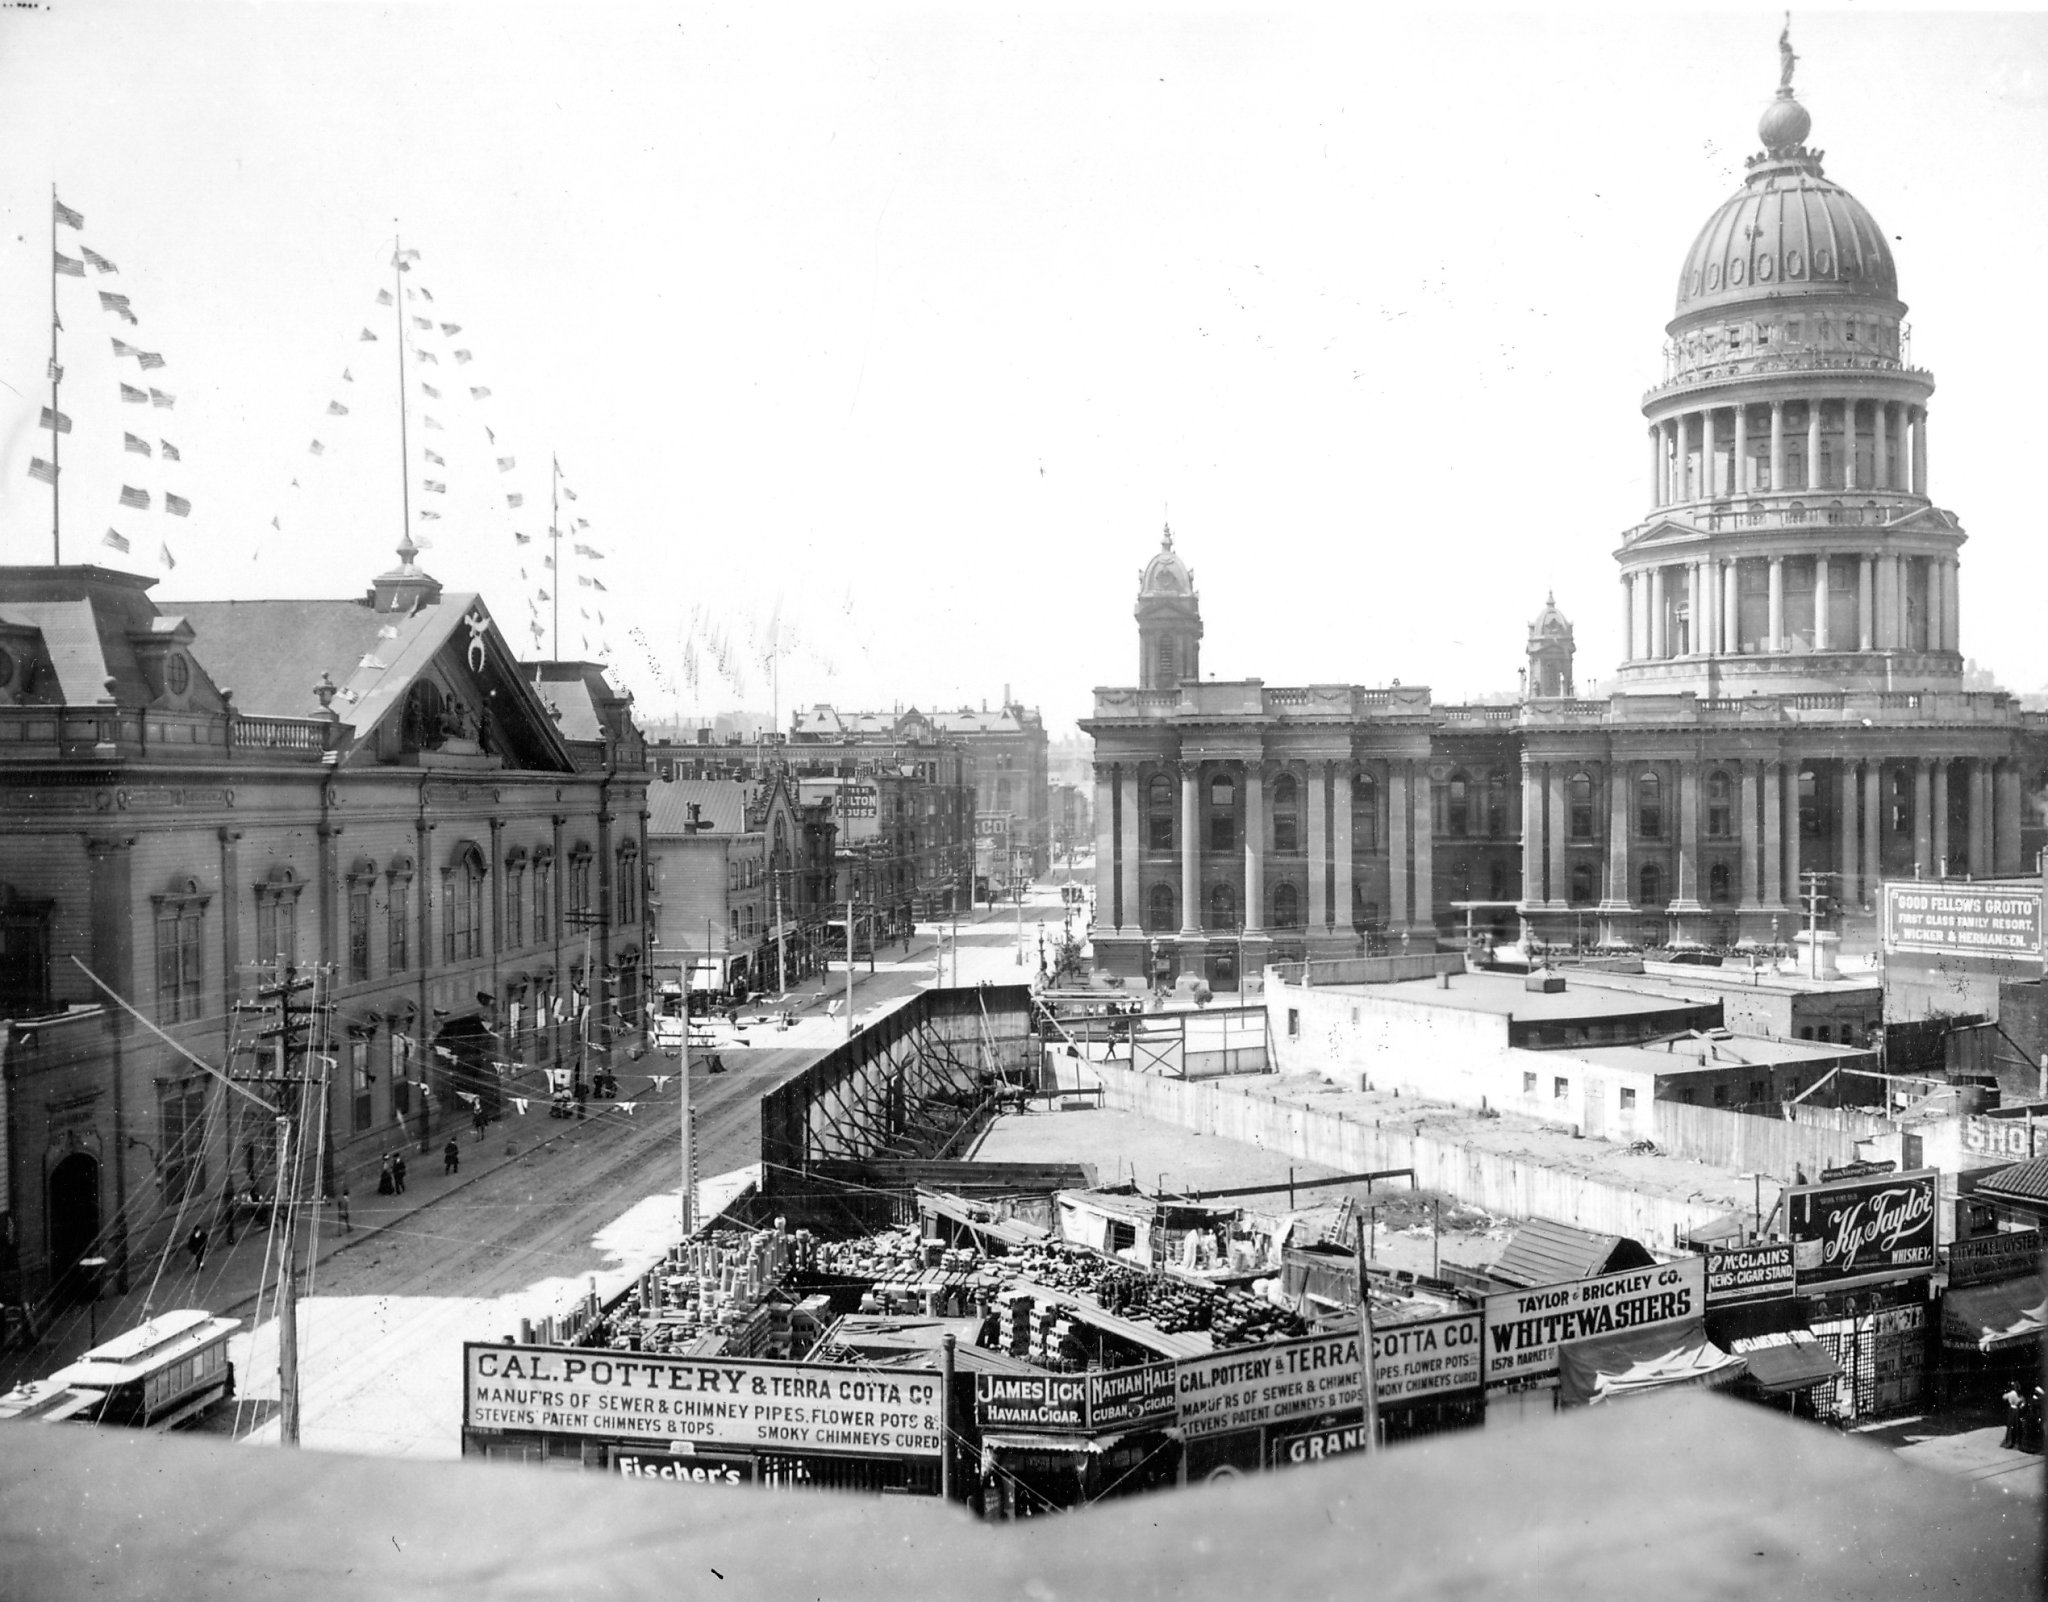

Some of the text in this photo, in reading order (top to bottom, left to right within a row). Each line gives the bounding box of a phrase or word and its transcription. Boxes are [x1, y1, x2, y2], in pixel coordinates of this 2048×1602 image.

[836, 795, 876, 807] FLTON
[1898, 913, 1923, 925] FIRST
[1926, 914, 1955, 926] CLASS
[1957, 916, 1989, 928] FAMILY
[1899, 897, 2033, 915] GOOD FELLOWS GROTTO
[1948, 929, 1956, 942] &
[1865, 1187, 1933, 1251] Taylor
[1518, 1291, 1569, 1314] TAYLOR
[1583, 1274, 1652, 1301] BRICKLEY
[1658, 1270, 1682, 1286] CO.
[1709, 1272, 1733, 1290] NEWS
[1737, 1268, 1765, 1284] CIGAR
[1490, 1288, 1691, 1353] WHITEWASHERS
[1212, 1358, 1271, 1387] POTTERY
[1275, 1355, 1285, 1375] &
[1286, 1340, 1359, 1373] TERRA
[1444, 1323, 1478, 1348] CO.
[1492, 1356, 1514, 1371] 1578
[1517, 1349, 1547, 1365] MARKET
[563, 1359, 747, 1393] POTTERY
[752, 1376, 767, 1396] &
[771, 1377, 831, 1399] TERRA
[840, 1381, 901, 1403] COTTA
[978, 1376, 1085, 1406] JAMES LICK
[1092, 1367, 1175, 1404] NATHAN HALE
[1243, 1390, 1258, 1404] OF
[1263, 1382, 1303, 1400] SEWER
[1307, 1380, 1315, 1392] &
[1404, 1359, 1442, 1375] FLOWER
[1445, 1354, 1469, 1369] POTS
[570, 1393, 590, 1408] OF
[600, 1395, 654, 1413] SEWER
[659, 1400, 669, 1414] &
[674, 1400, 748, 1419] CHIMNEY
[812, 1409, 874, 1427] FLOWER
[881, 1413, 918, 1430] POTS
[1232, 1406, 1270, 1425] PATENT
[1274, 1395, 1325, 1418] CHIMNEYS
[1329, 1393, 1336, 1406] &
[1377, 1383, 1403, 1397] MOKY
[1406, 1373, 1451, 1392] CHIMNEYS
[1453, 1371, 1478, 1385] CURED
[542, 1412, 588, 1427] PATENT
[594, 1415, 661, 1432] CHIMNEYS
[667, 1420, 677, 1433] &
[988, 1405, 1038, 1421] HAVANA
[1093, 1406, 1128, 1421] CUBAN
[758, 1426, 940, 1449] SMOKY CHIMNEYS CURED
[619, 1457, 741, 1486] Fischer's
